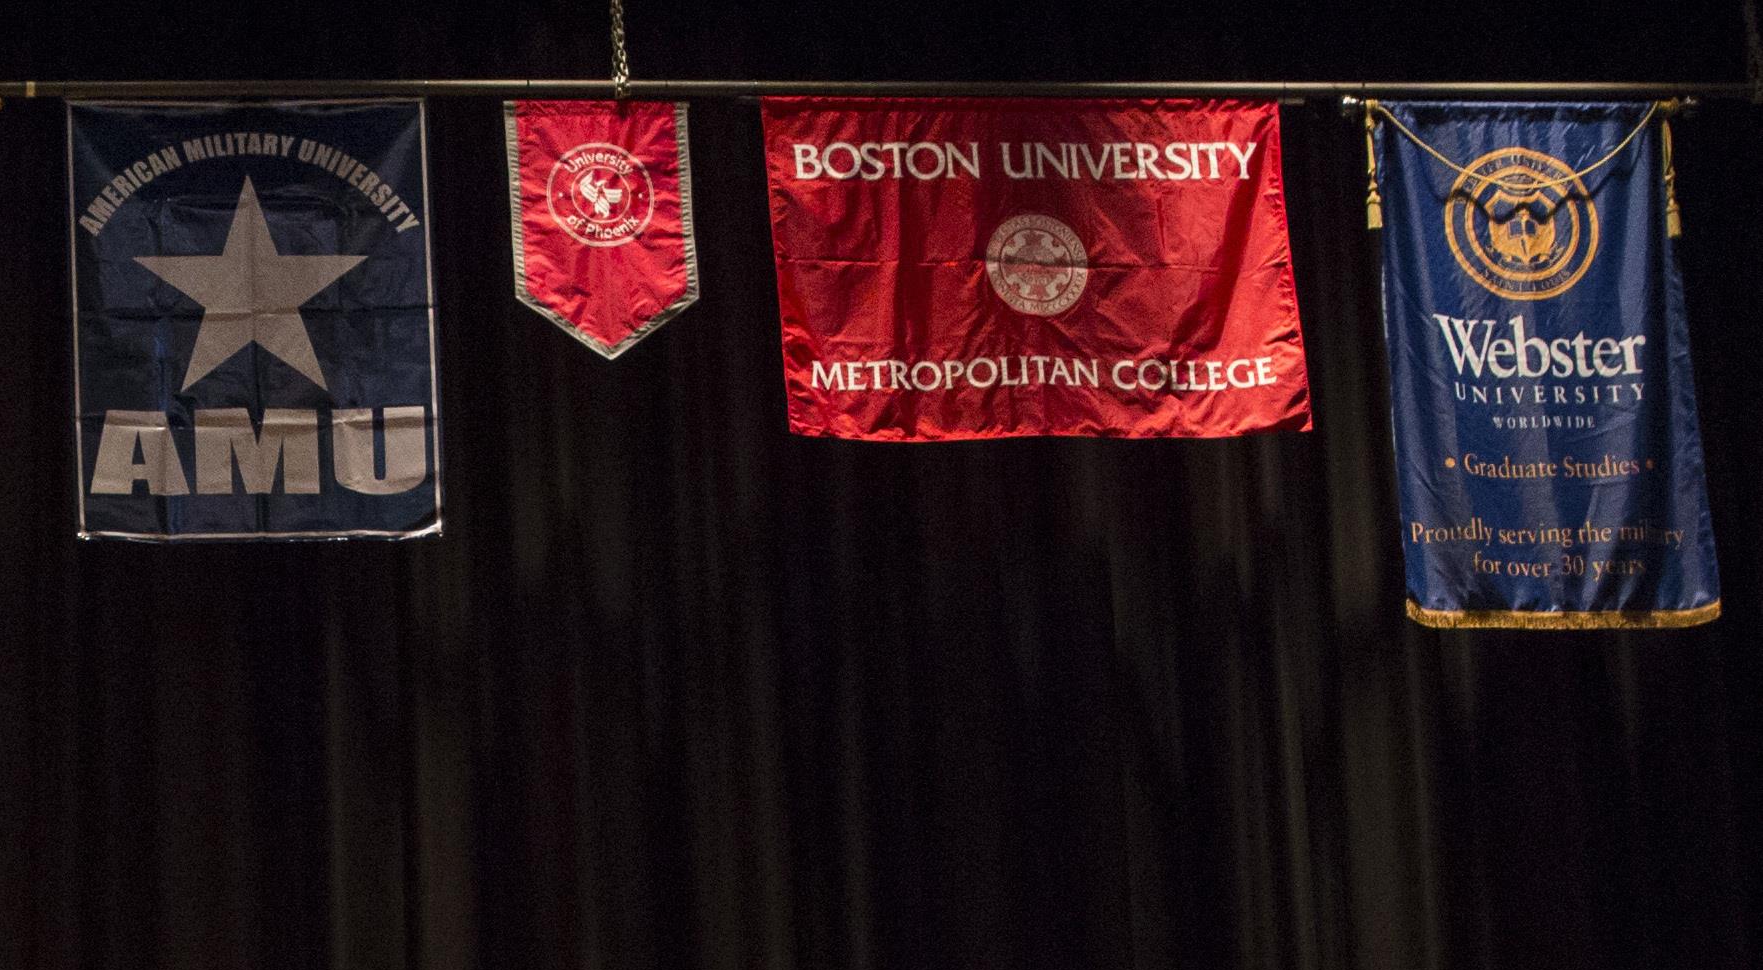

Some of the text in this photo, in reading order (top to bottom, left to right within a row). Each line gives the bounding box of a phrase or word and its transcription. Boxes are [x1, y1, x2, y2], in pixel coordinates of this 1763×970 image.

[564, 151, 634, 176] University
[793, 141, 1257, 181] BOSTON UNIVERSITY
[79, 132, 421, 237] AMERICAN MILITARY UNIVERSITY
[567, 215, 640, 239] of Phoenix
[1432, 313, 1647, 379] Webster
[811, 356, 1277, 391] METROPOLITAN COLLEGE
[1454, 382, 1646, 405] UNIVERSITY
[1492, 416, 1595, 430] WORLDWIDE
[90, 406, 427, 496] AMU
[1463, 453, 1639, 479] Graduate Studies
[1410, 517, 1493, 546] Proudly
[1498, 522, 1573, 548] serving
[1577, 520, 1612, 544] the
[1473, 550, 1501, 574] for
[1507, 559, 1552, 578] over
[1560, 555, 1585, 576] 30
